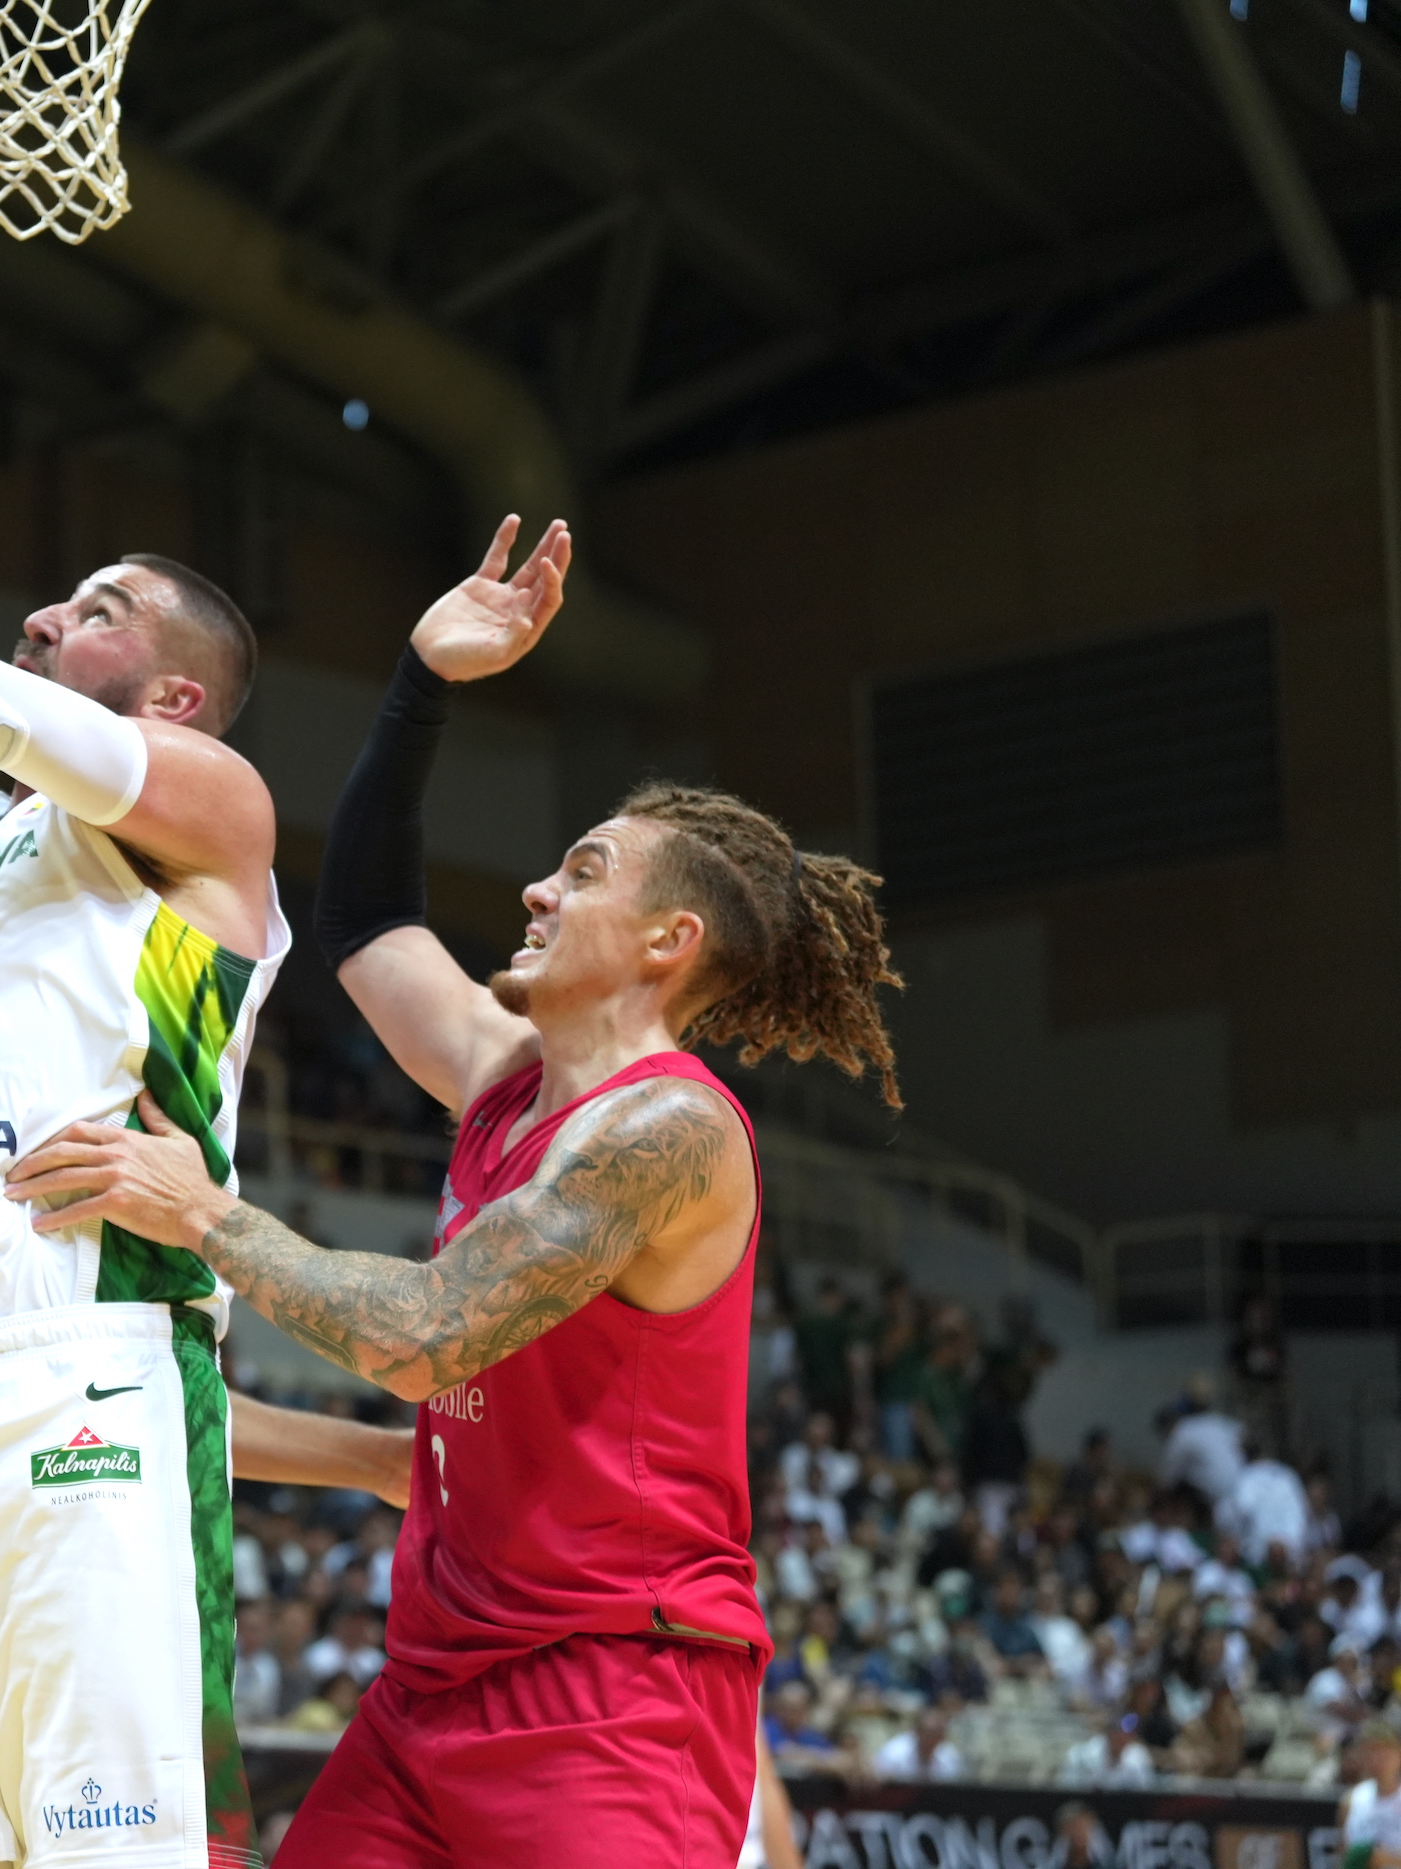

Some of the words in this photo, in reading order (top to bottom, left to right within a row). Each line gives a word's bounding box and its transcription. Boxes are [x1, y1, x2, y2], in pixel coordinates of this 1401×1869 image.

[33, 1451, 138, 1480] Kalnapilis
[51, 1490, 127, 1505] NEALKOHOLINIS
[43, 1800, 157, 1838] Vytautas
